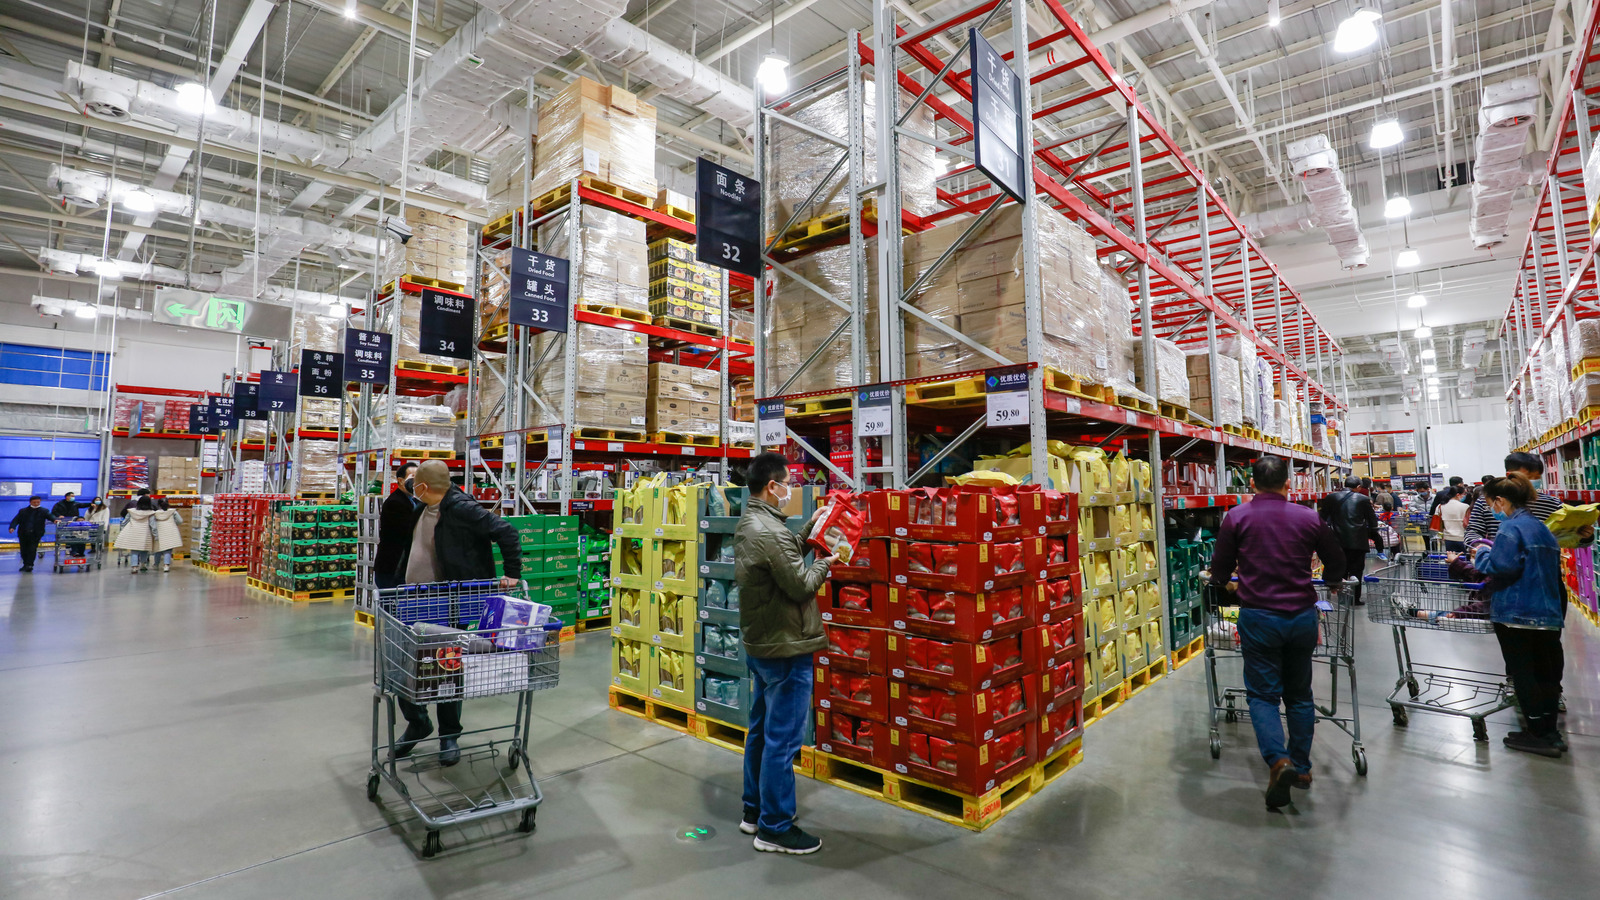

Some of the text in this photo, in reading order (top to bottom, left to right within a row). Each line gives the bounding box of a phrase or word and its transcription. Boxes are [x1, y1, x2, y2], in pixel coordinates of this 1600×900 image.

[987, 51, 1010, 90] 干货
[716, 170, 745, 195] 面条
[721, 188, 741, 201] Noodles
[722, 243, 740, 263] 32
[528, 255, 555, 271] 干货
[528, 267, 542, 275] Dried
[527, 279, 554, 295] 罐头
[434, 294, 464, 309] 调味料
[437, 306, 461, 314] Condiment
[532, 309, 549, 323] 33
[359, 332, 380, 343] 酱油
[439, 340, 455, 352] 34
[314, 353, 333, 362] 杂粮
[355, 349, 382, 360] 调味料
[312, 368, 332, 377] 面粉
[361, 369, 375, 379] 35
[1000, 373, 1026, 382] 优质优价
[314, 385, 327, 393] 36
[869, 390, 890, 398] 优质优价
[996, 409, 1020, 421] 59.80
[865, 421, 884, 432] 59.80
[766, 432, 781, 441] 66.90
[801, 756, 812, 769] 20
[889, 784, 894, 795] L
